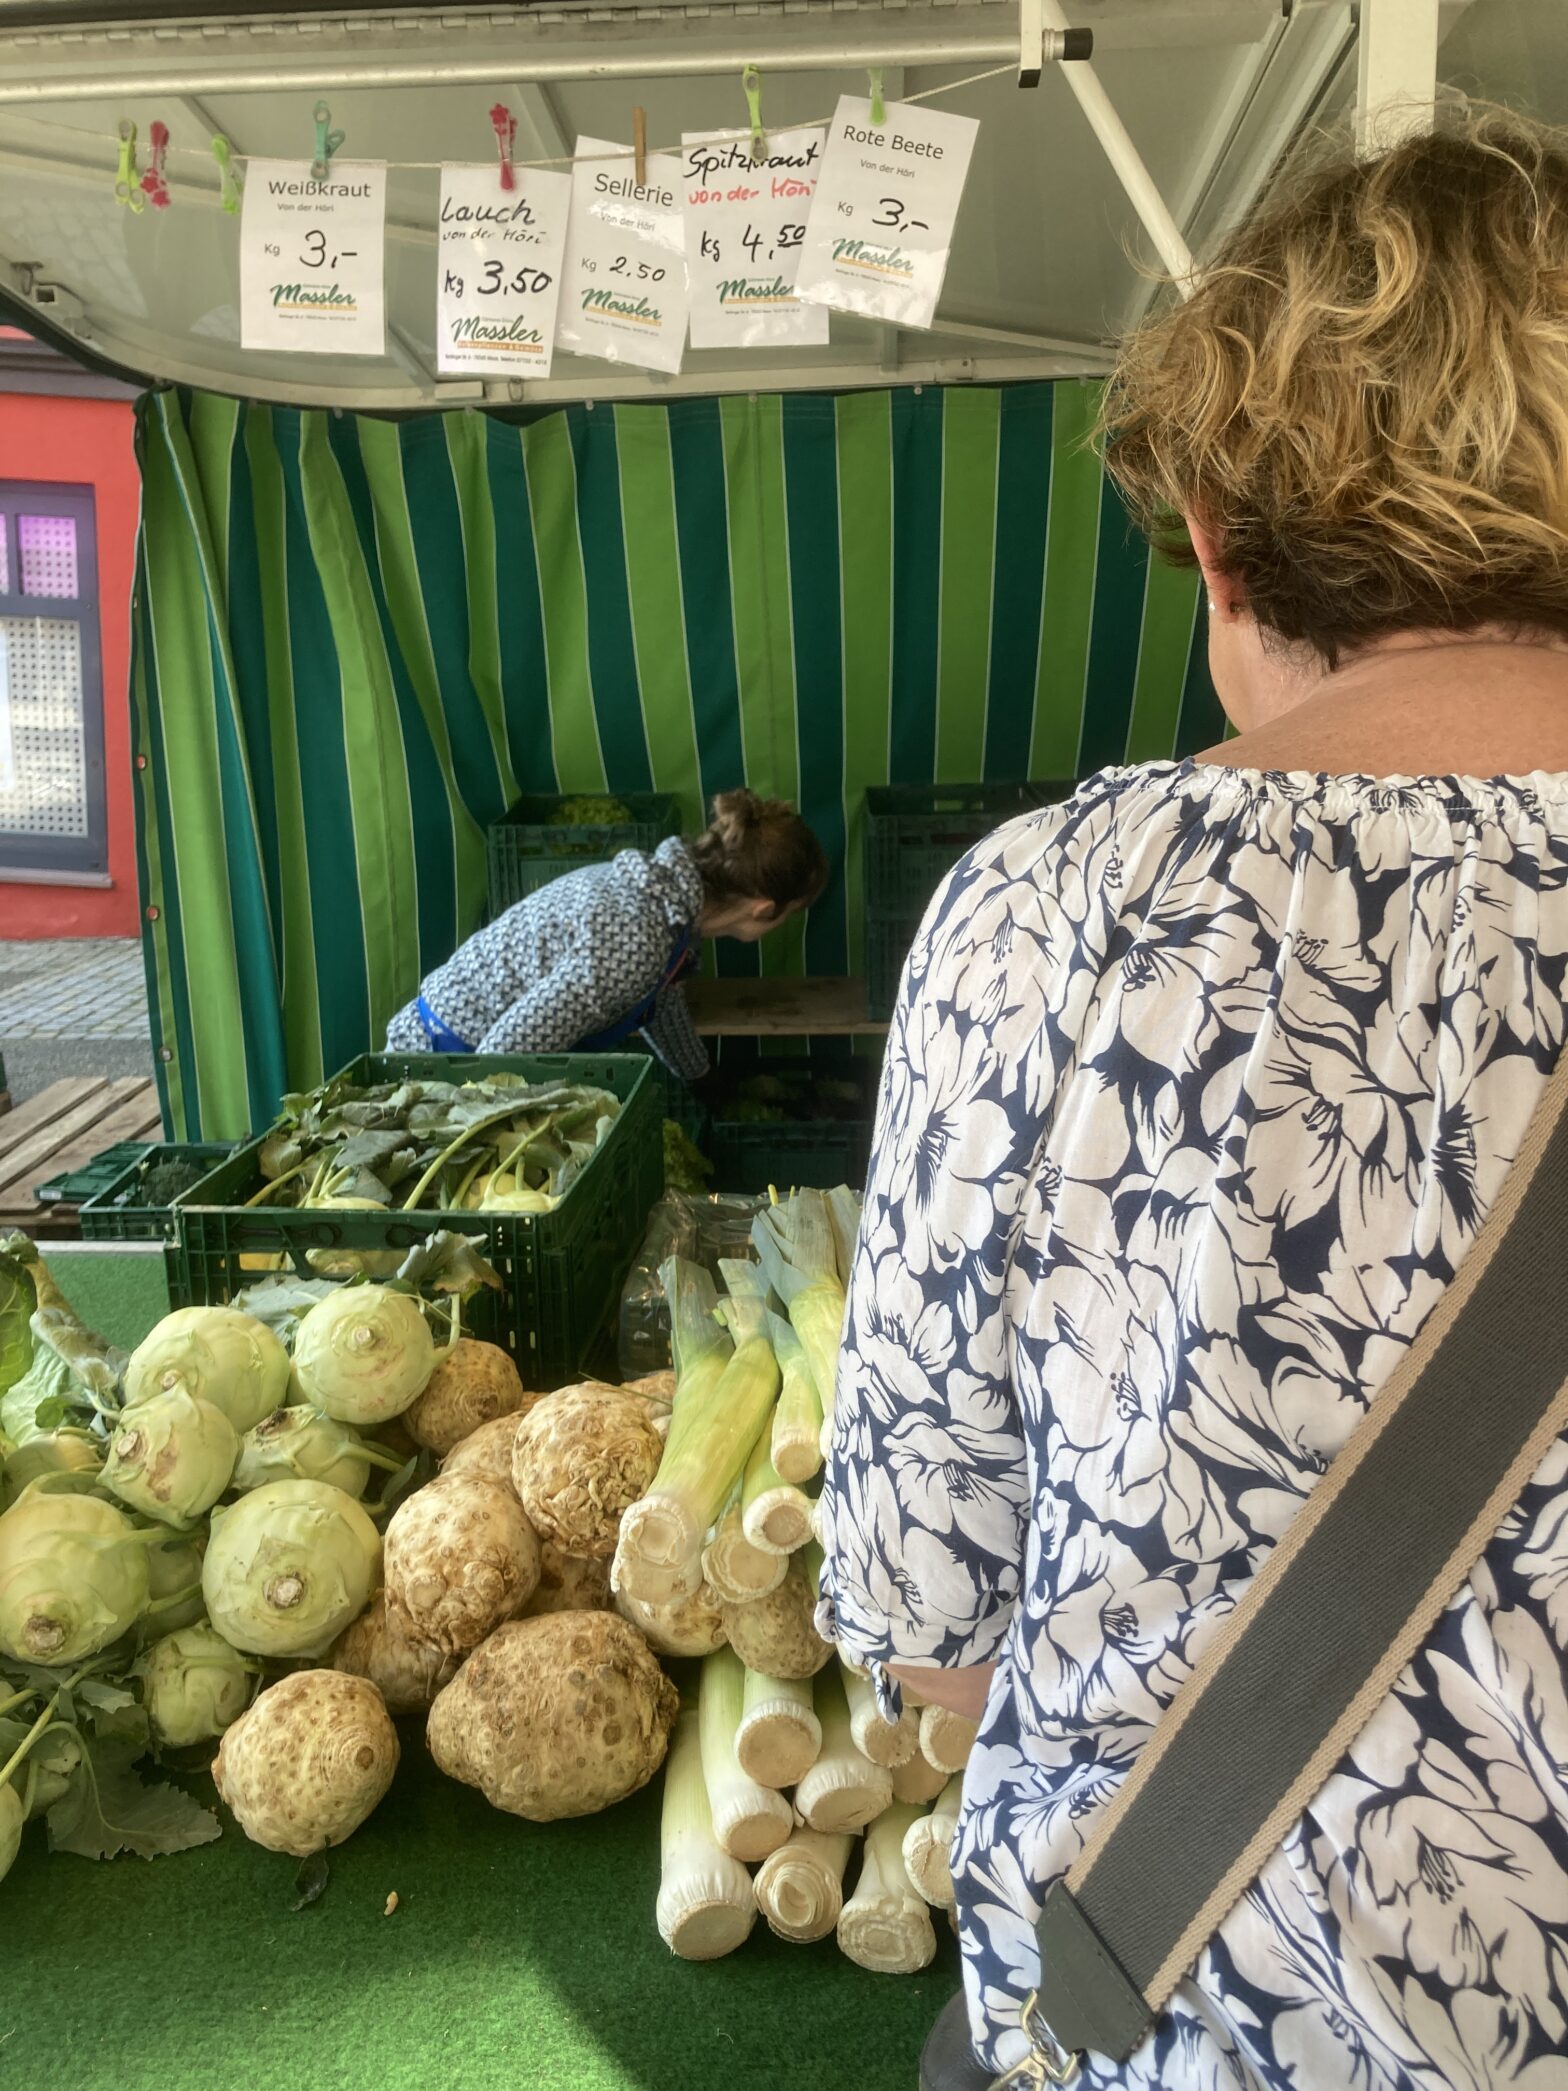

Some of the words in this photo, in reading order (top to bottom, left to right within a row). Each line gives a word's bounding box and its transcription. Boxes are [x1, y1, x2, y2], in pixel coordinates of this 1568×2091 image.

[843, 124, 885, 147] Rote
[891, 134, 944, 160] Beete
[860, 159, 877, 170] Von
[878, 162, 895, 174] der
[268, 180, 372, 198] Weißkraut
[594, 173, 674, 207] Sellerie
[688, 189, 722, 205] von
[727, 184, 760, 201] der
[277, 203, 295, 211] Von
[297, 203, 312, 211] der
[315, 203, 334, 212] Höri
[837, 201, 854, 217] Kg
[600, 212, 618, 223] Von
[619, 214, 635, 228] der
[442, 231, 466, 241] von
[471, 228, 495, 239] der
[264, 243, 280, 256] Kg
[832, 237, 914, 272] Massler
[581, 257, 597, 273] Kg
[477, 260, 553, 296] 3,50
[269, 283, 356, 307] Massler
[581, 287, 662, 320] Massler
[451, 314, 543, 343] Massler
